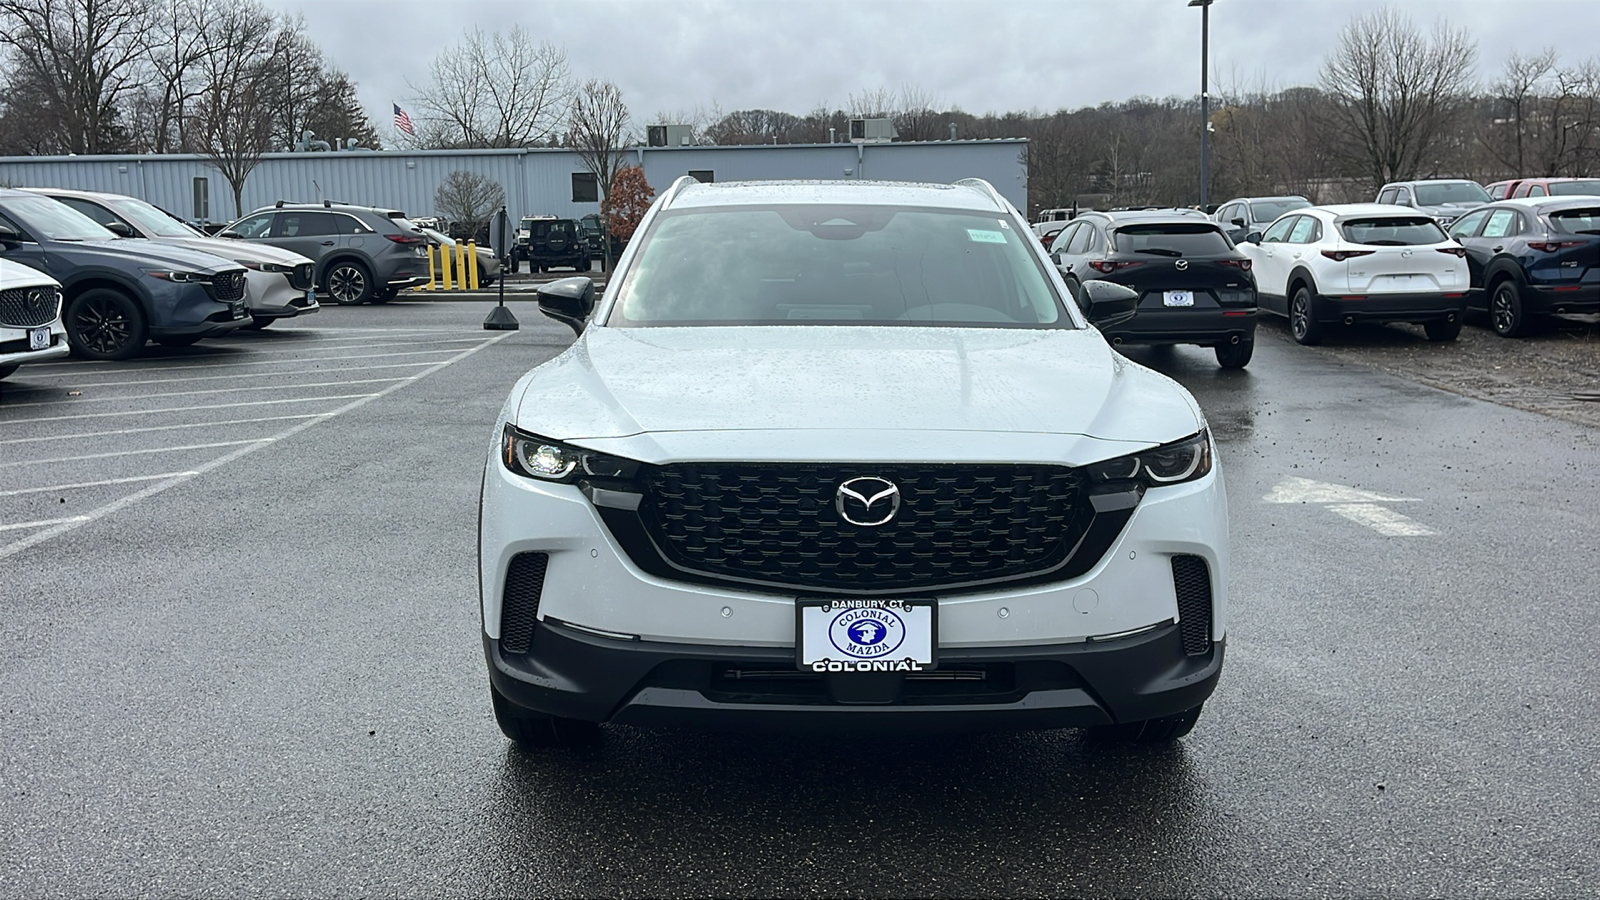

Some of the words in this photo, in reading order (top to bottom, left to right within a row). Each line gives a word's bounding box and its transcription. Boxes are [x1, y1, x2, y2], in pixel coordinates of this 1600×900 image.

[889, 600, 904, 608] CT
[838, 609, 896, 627] COLONIAL
[845, 642, 890, 655] MAZDA
[812, 660, 922, 672] COLONIAL
